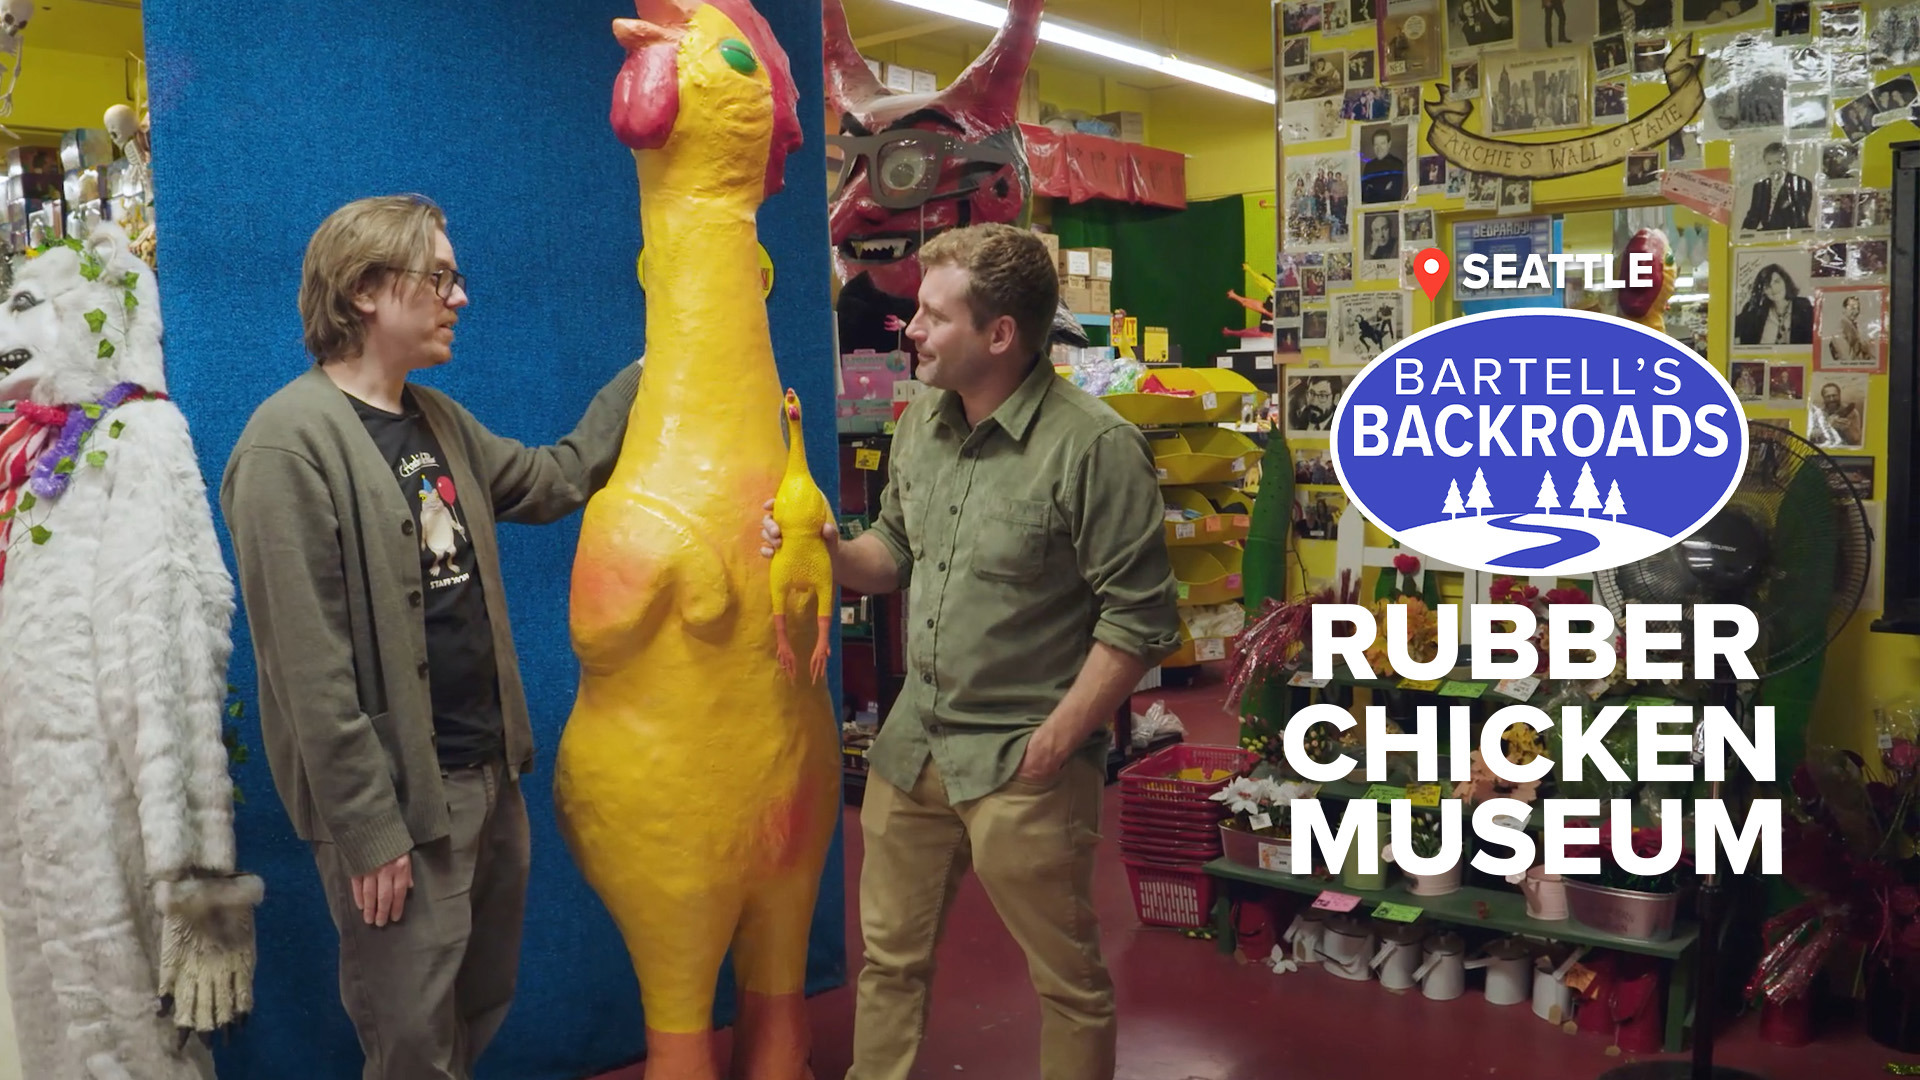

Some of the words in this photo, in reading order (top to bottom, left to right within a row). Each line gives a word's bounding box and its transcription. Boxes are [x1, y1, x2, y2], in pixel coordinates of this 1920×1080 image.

[1445, 132, 1534, 169] ARCHIE'S
[1550, 142, 1603, 170] WALL
[1629, 103, 1683, 145] FAME
